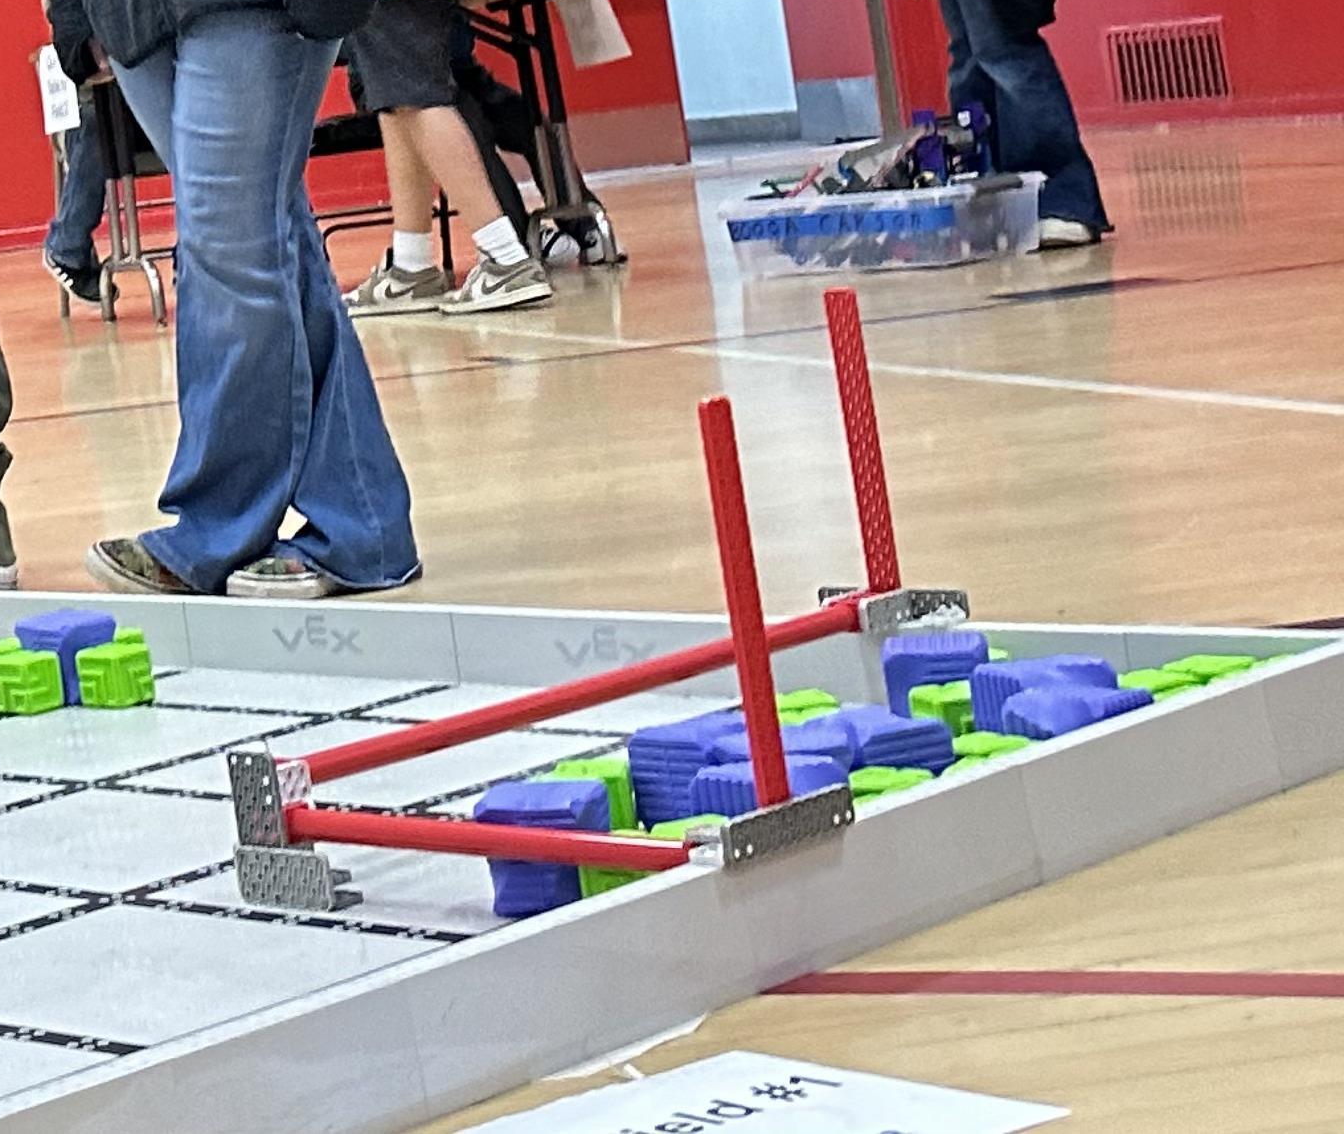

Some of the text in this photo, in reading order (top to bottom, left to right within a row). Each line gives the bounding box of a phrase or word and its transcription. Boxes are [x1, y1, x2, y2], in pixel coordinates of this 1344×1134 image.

[272, 614, 364, 653] VEX
[619, 1076, 843, 1134] eld #1
